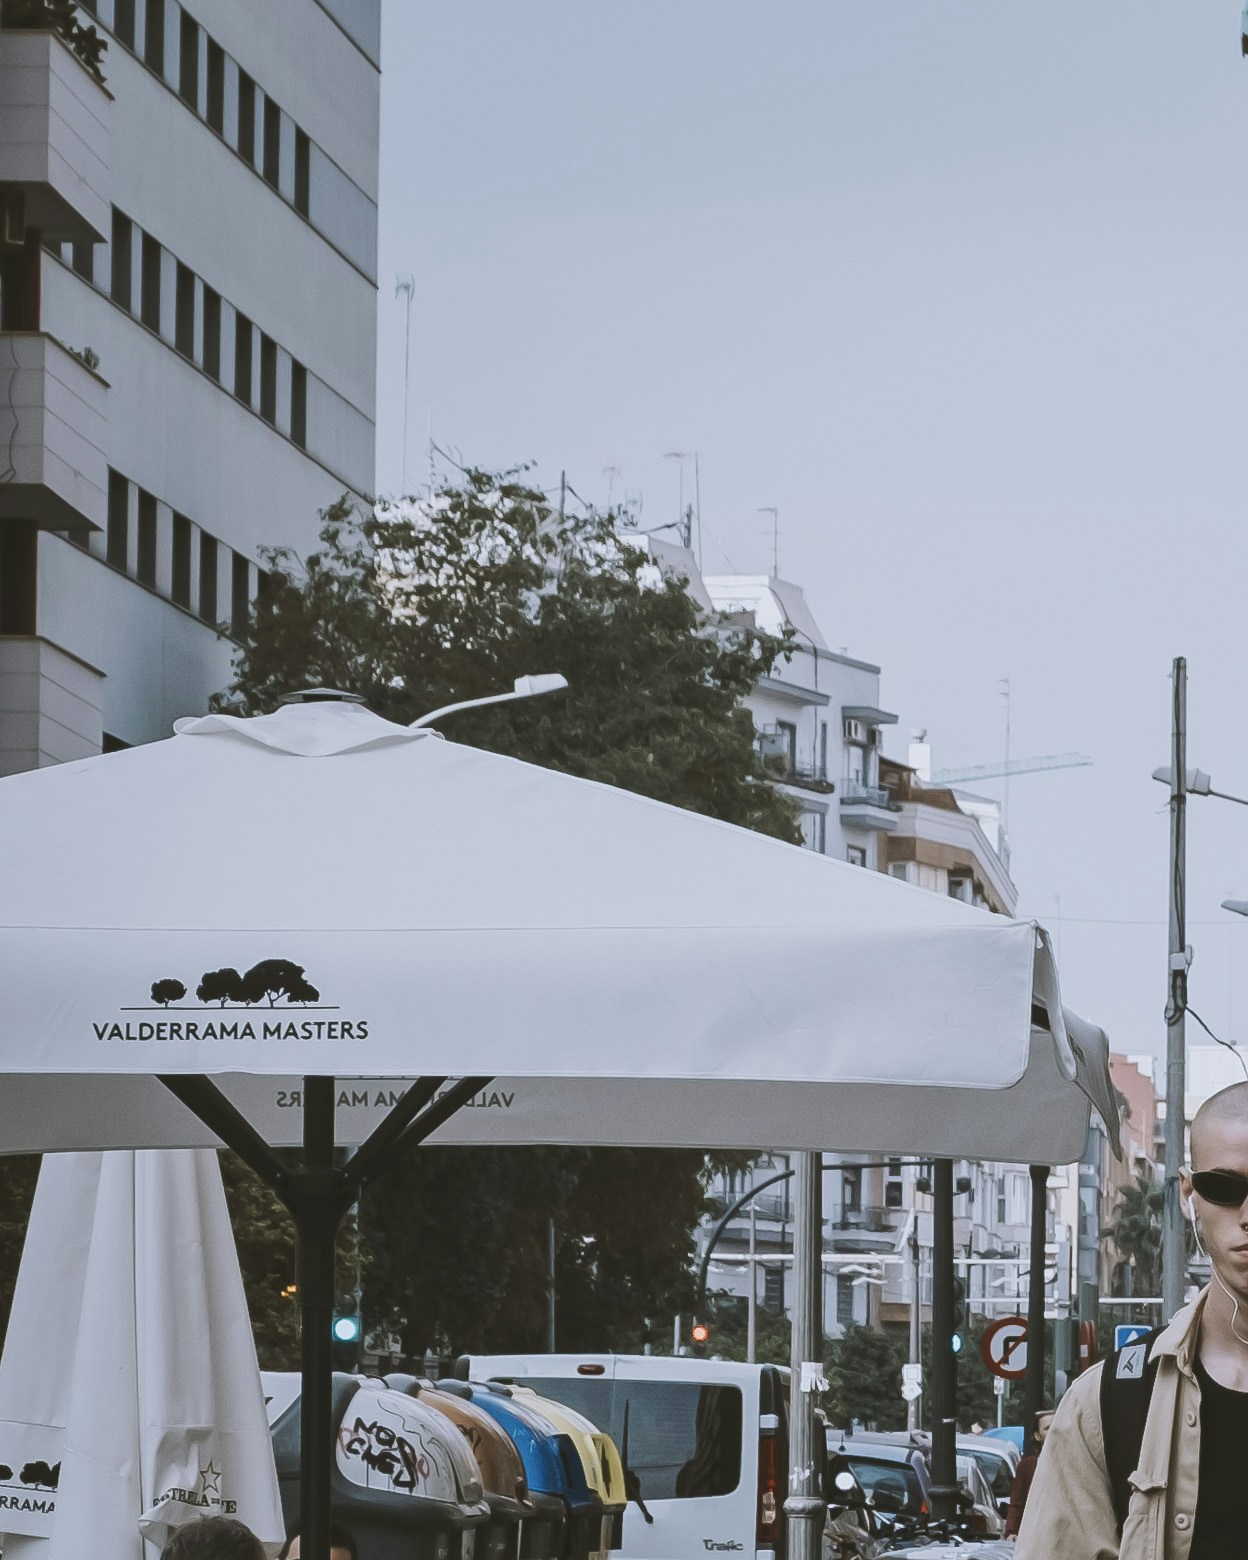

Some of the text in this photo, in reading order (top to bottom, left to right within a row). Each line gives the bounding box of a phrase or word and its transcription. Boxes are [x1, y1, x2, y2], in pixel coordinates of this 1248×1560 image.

[92, 1020, 369, 1041] VALDERRAMA MASTERS
[703, 1539, 744, 1551] Trafic
